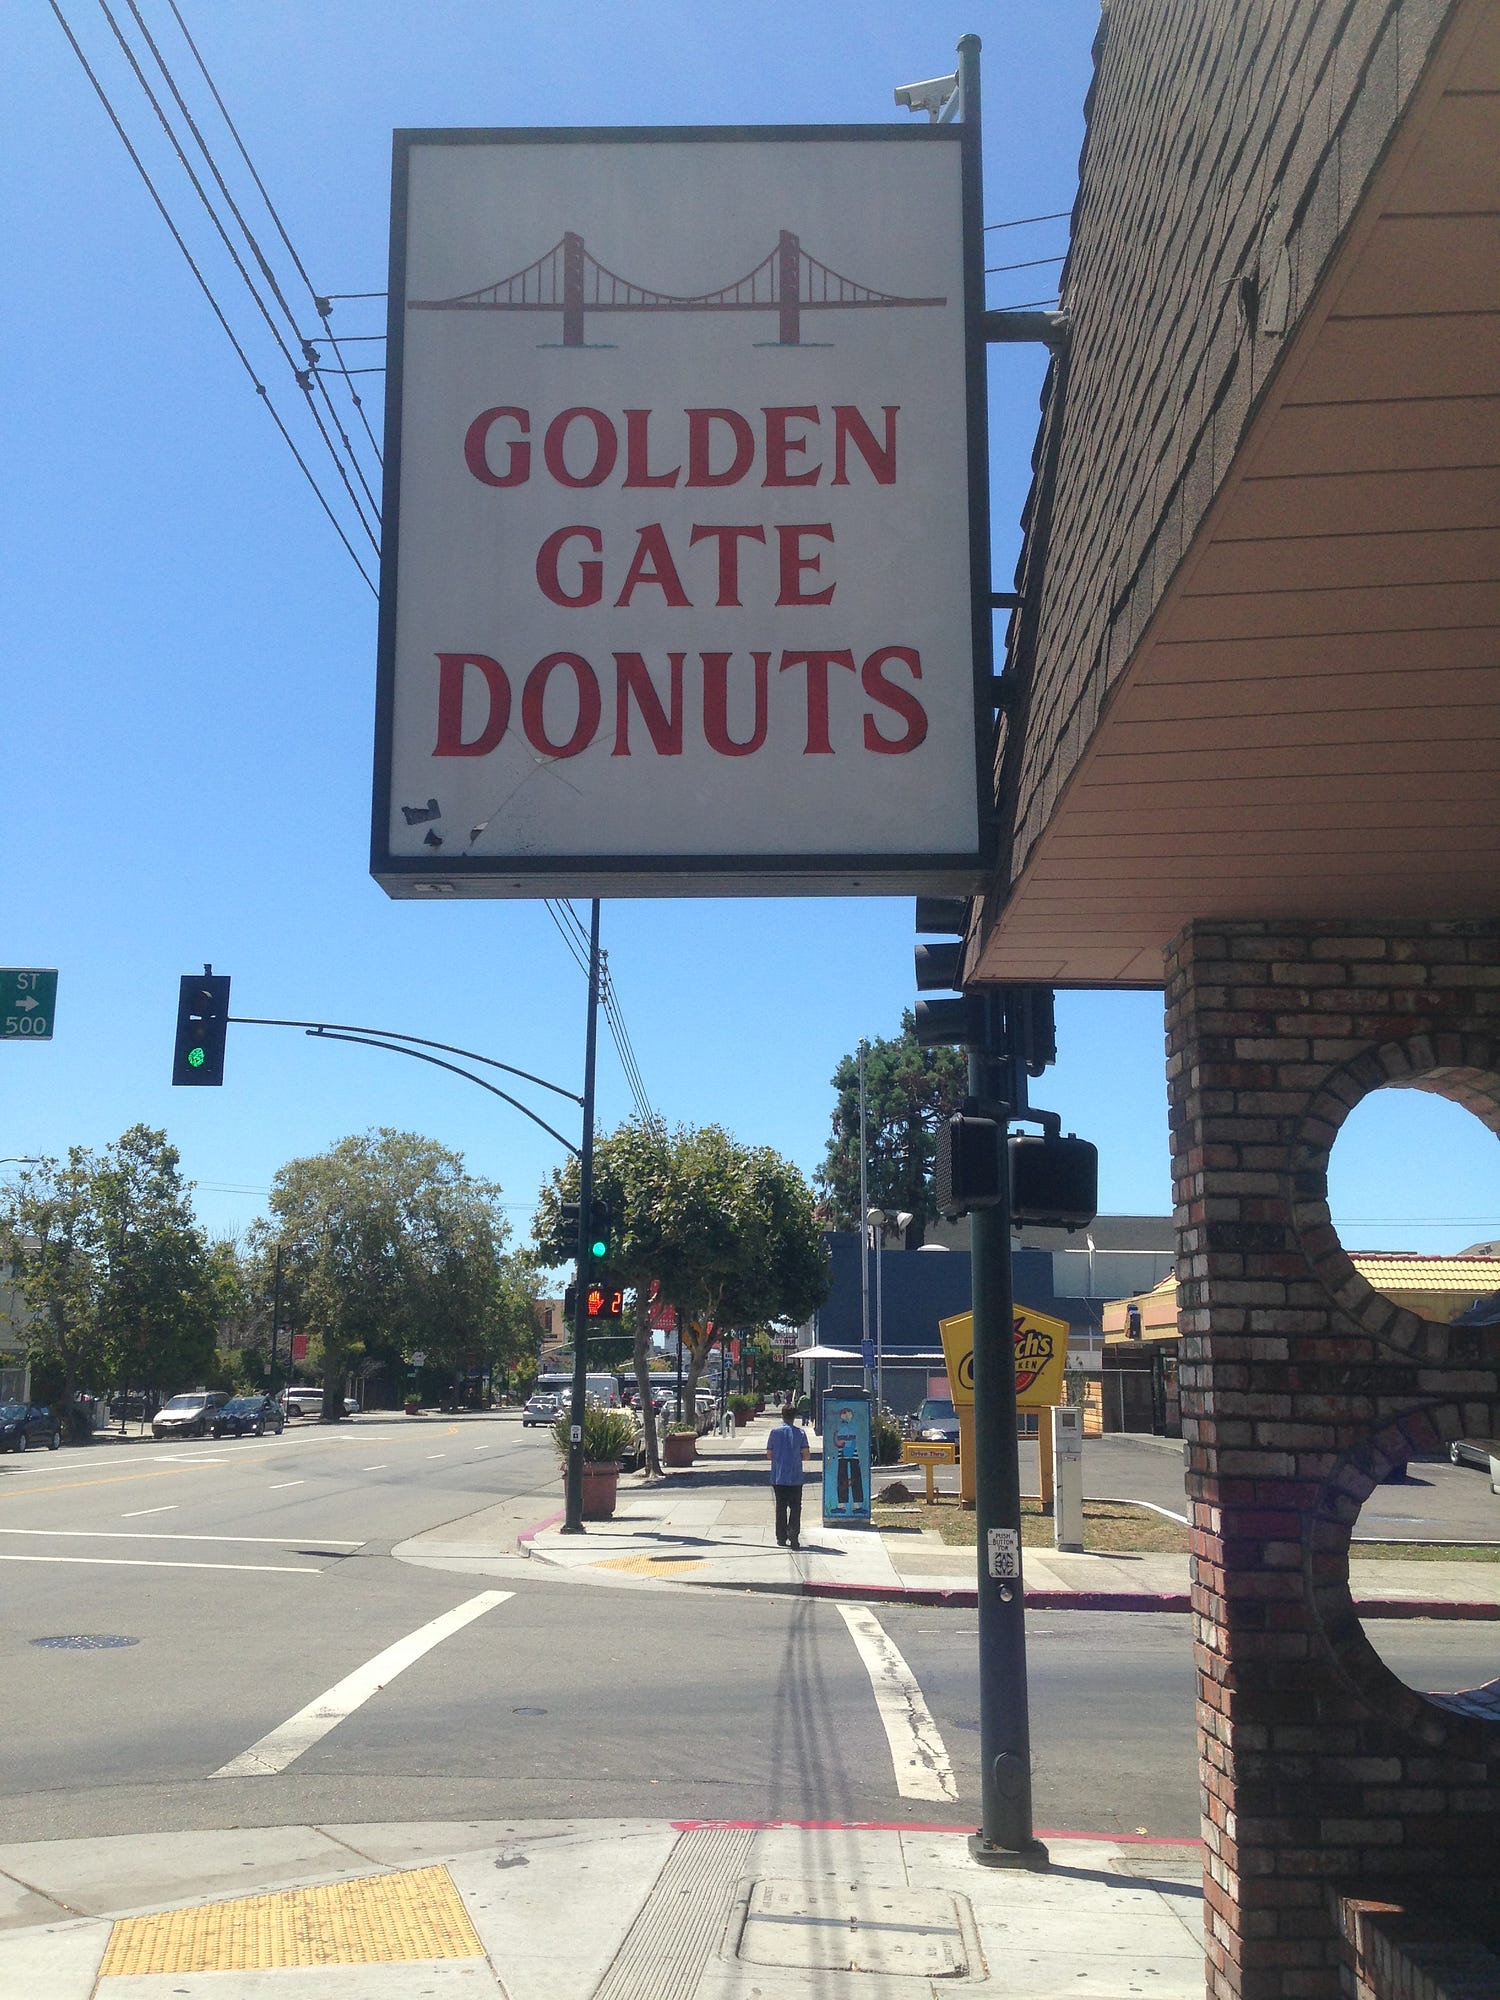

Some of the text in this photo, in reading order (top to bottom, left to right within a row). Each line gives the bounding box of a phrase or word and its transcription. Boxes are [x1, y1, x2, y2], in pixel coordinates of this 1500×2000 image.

[464, 405, 900, 488] GOLDEN
[536, 523, 837, 608] GATE
[431, 645, 928, 757] DONUTS
[16, 973, 40, 990] ST
[6, 1017, 47, 1034] 500
[611, 1292, 621, 1313] 2
